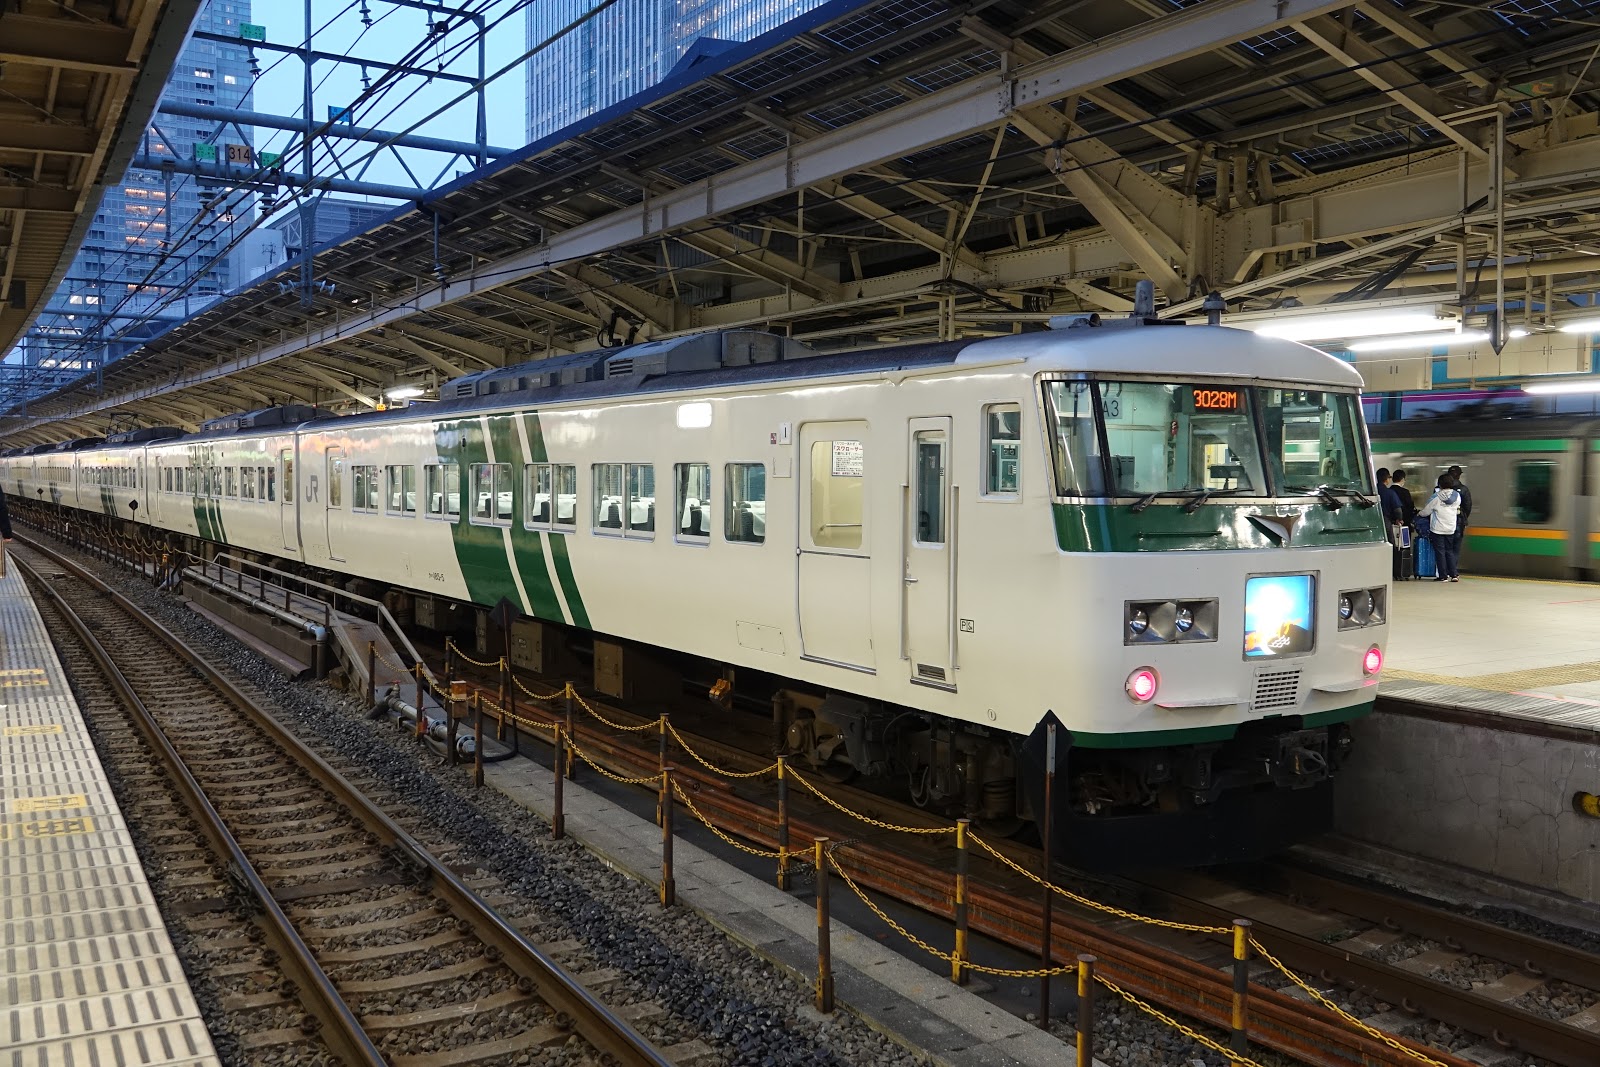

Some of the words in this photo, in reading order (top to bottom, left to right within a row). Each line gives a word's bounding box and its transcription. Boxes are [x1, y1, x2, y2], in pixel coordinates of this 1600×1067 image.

[228, 146, 250, 162] 314
[1193, 389, 1237, 408] 3028M
[1103, 400, 1119, 417] A3
[305, 475, 318, 503] JR
